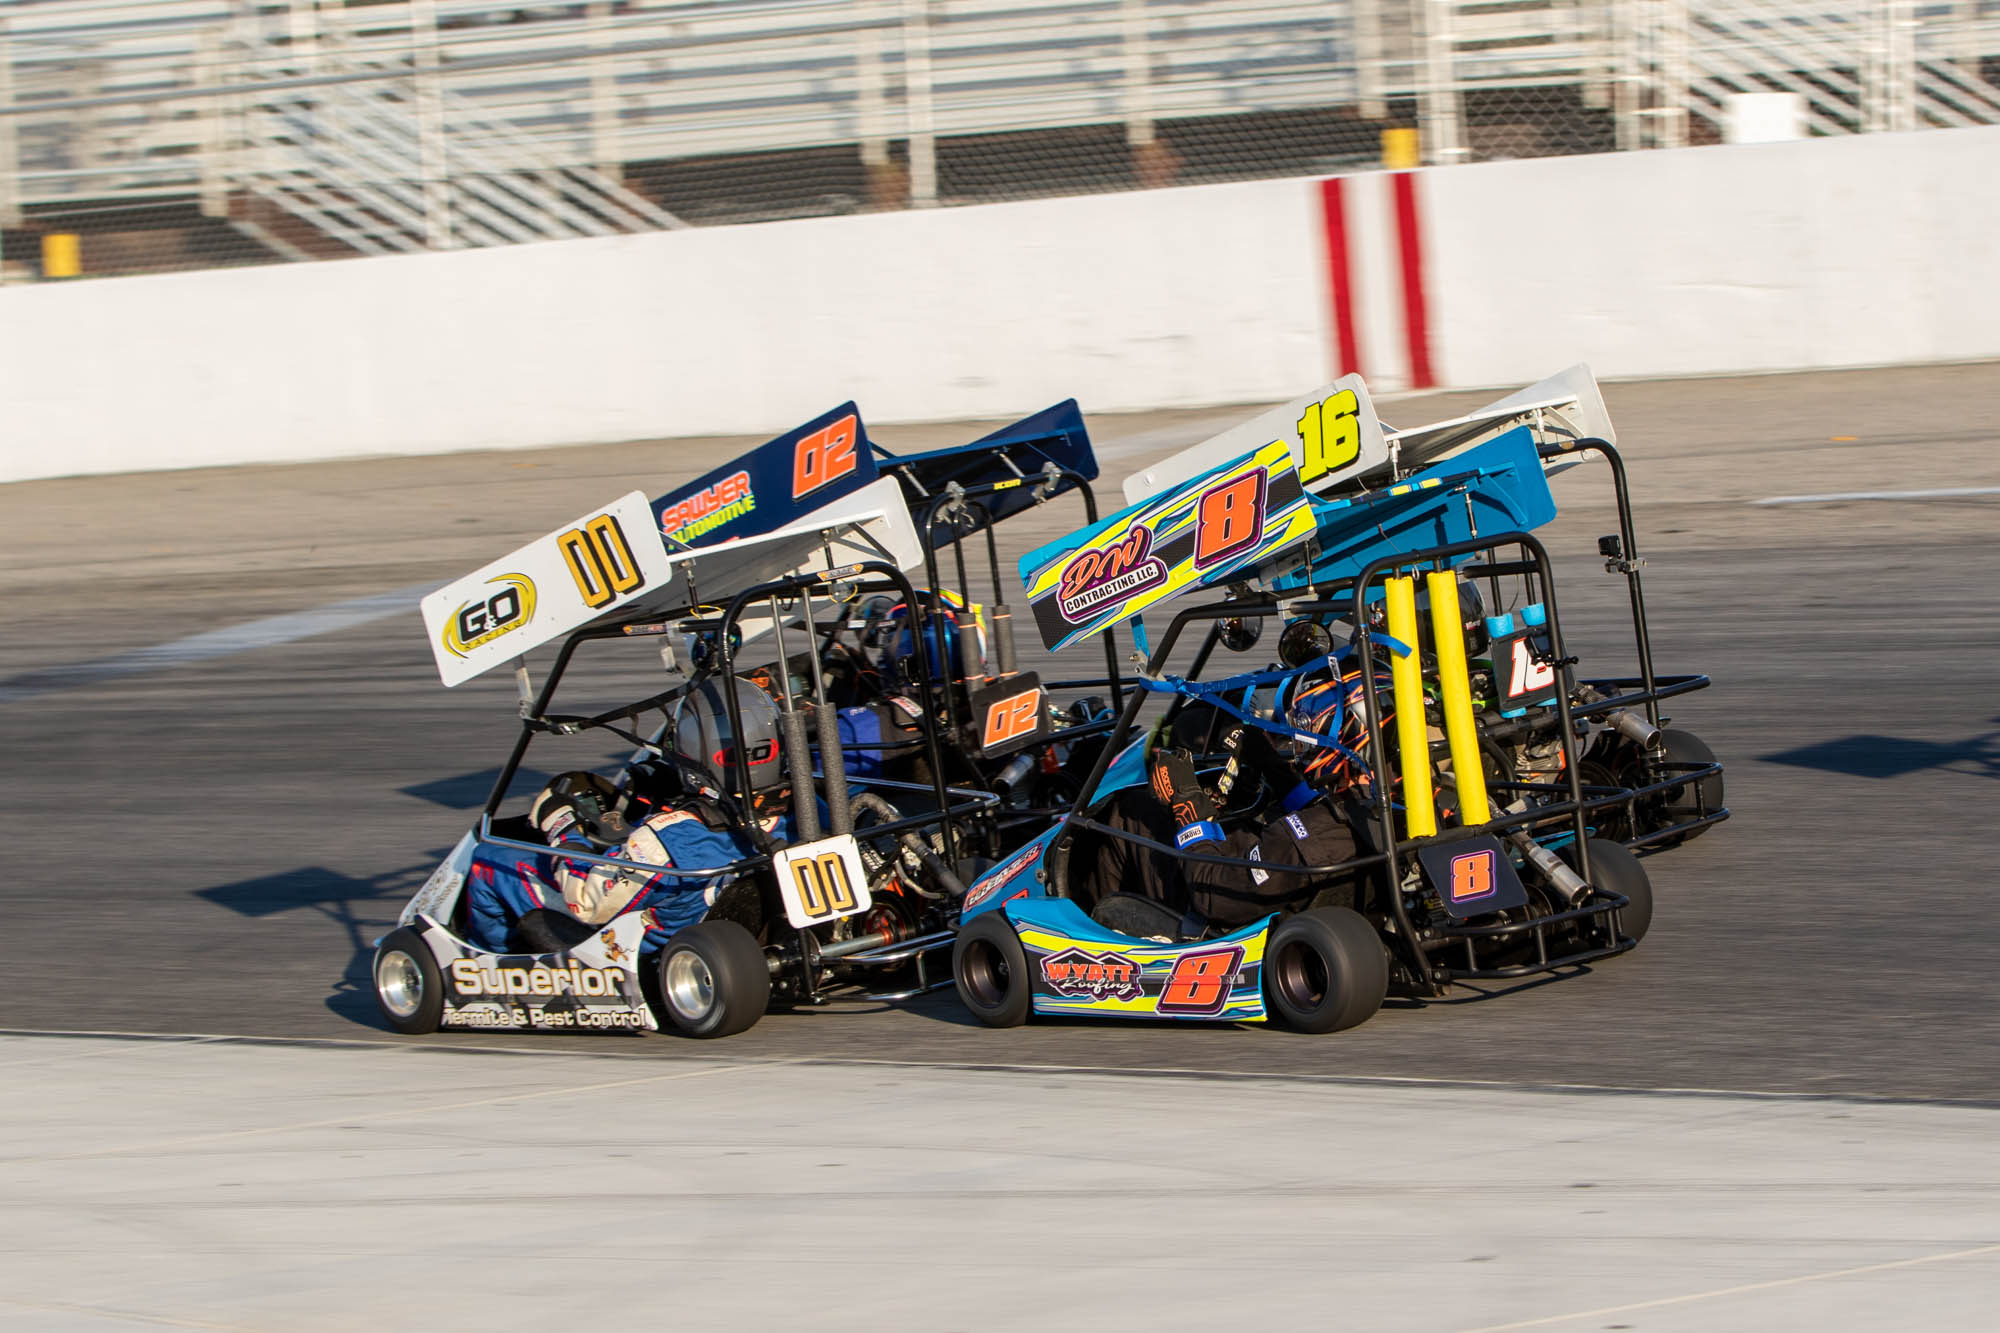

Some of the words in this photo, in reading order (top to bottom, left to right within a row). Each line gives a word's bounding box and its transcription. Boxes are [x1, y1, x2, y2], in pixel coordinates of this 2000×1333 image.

[793, 413, 858, 500] 02
[1297, 388, 1361, 487] 16
[661, 470, 752, 535] SAWYER
[1197, 467, 1265, 569] 8
[557, 514, 646, 610] 00
[1066, 577, 1136, 612] CONTRACTING
[1137, 565, 1158, 585] LLC.
[983, 688, 1041, 749] 02
[789, 852, 856, 918] 00
[1451, 850, 1496, 902] 8
[452, 958, 625, 997] Superior
[1047, 963, 1133, 981] WYATT
[1060, 977, 1135, 995] Roofing
[1161, 949, 1237, 1006] 8
[443, 1006, 510, 1025] Termite
[513, 1008, 528, 1025] &
[529, 1008, 574, 1026] Pest
[576, 1008, 648, 1027] Control
